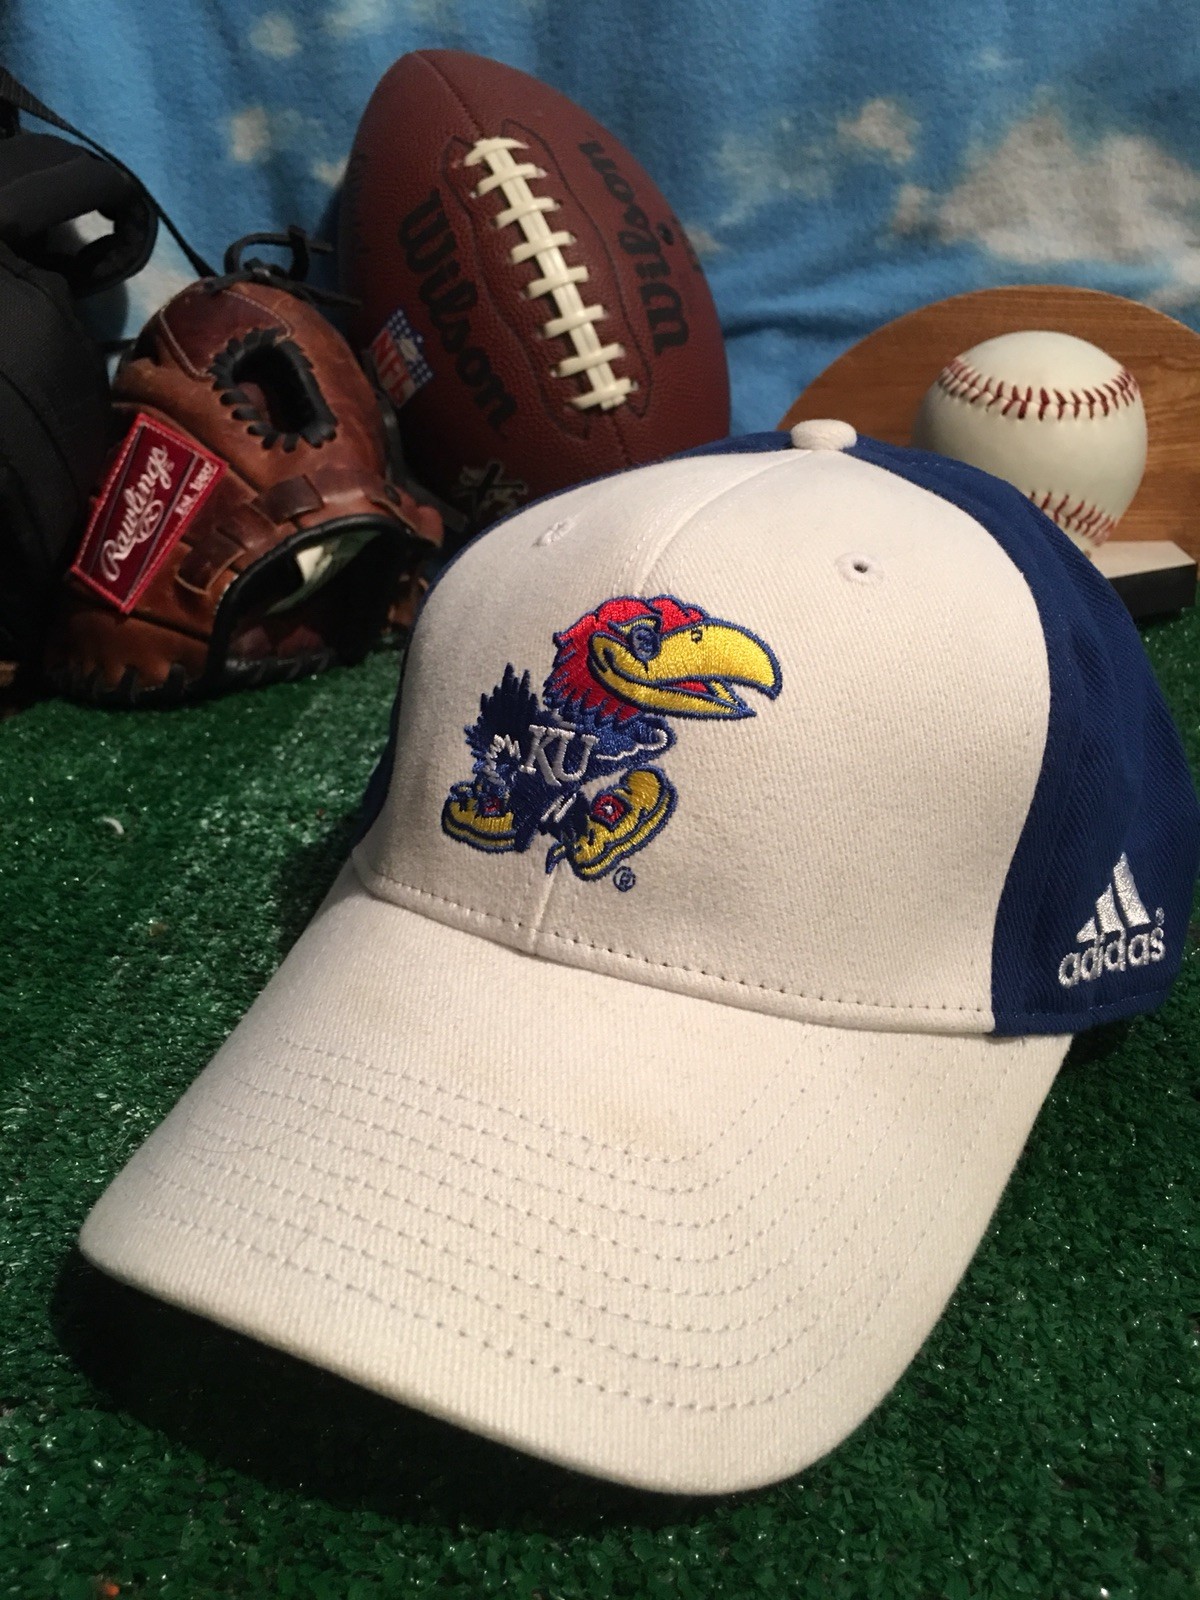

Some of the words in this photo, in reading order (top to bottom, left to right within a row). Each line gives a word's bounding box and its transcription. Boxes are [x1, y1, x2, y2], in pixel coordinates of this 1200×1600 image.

[578, 140, 690, 356] Wilson
[398, 189, 518, 430] Wilson
[373, 331, 410, 401] NFL
[101, 445, 172, 581] Rawlings
[519, 724, 600, 787] KU
[1058, 927, 1166, 989] adidas
